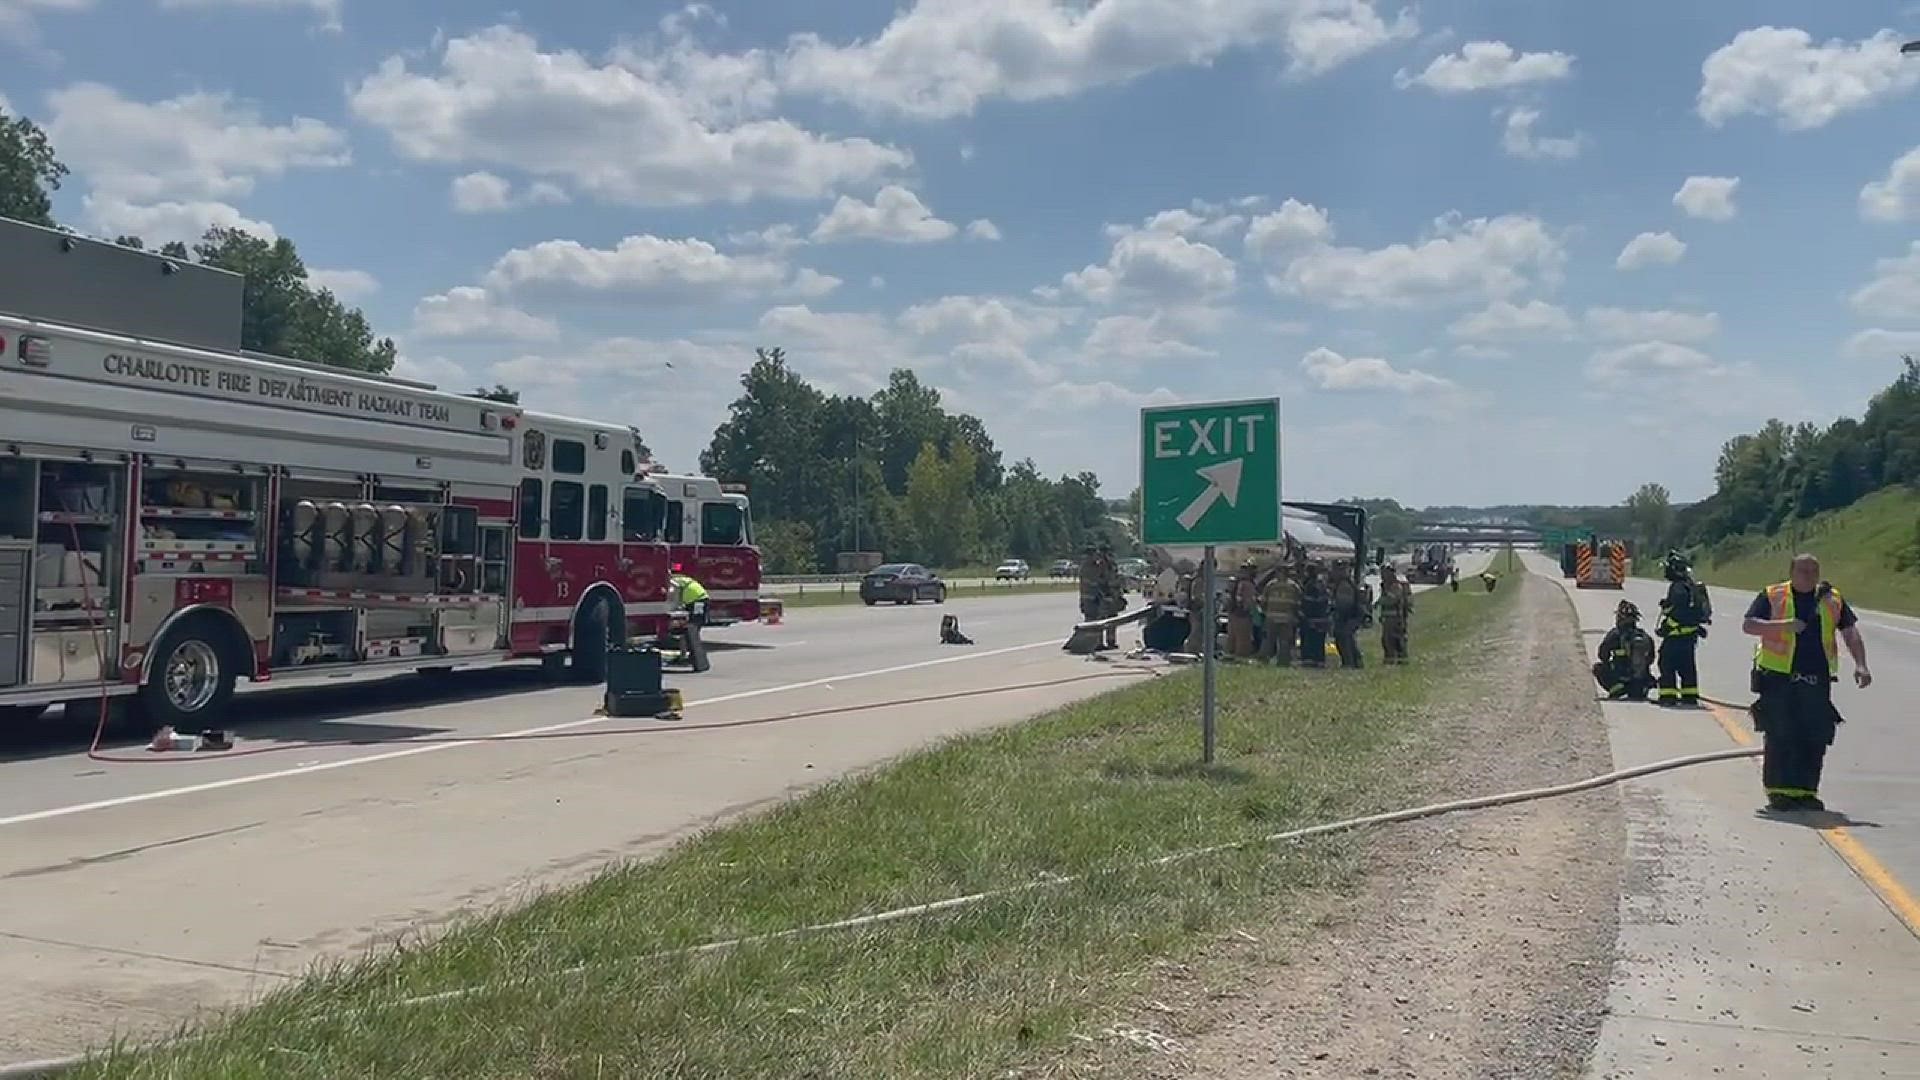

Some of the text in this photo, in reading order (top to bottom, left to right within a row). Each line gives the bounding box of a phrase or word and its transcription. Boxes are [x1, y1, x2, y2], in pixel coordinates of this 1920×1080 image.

[103, 354, 450, 423] CHARLOTTE FIRE DEPARTMENT HAZMAT TEAM
[1155, 414, 1265, 458] EXIT
[557, 581, 569, 599] 13
